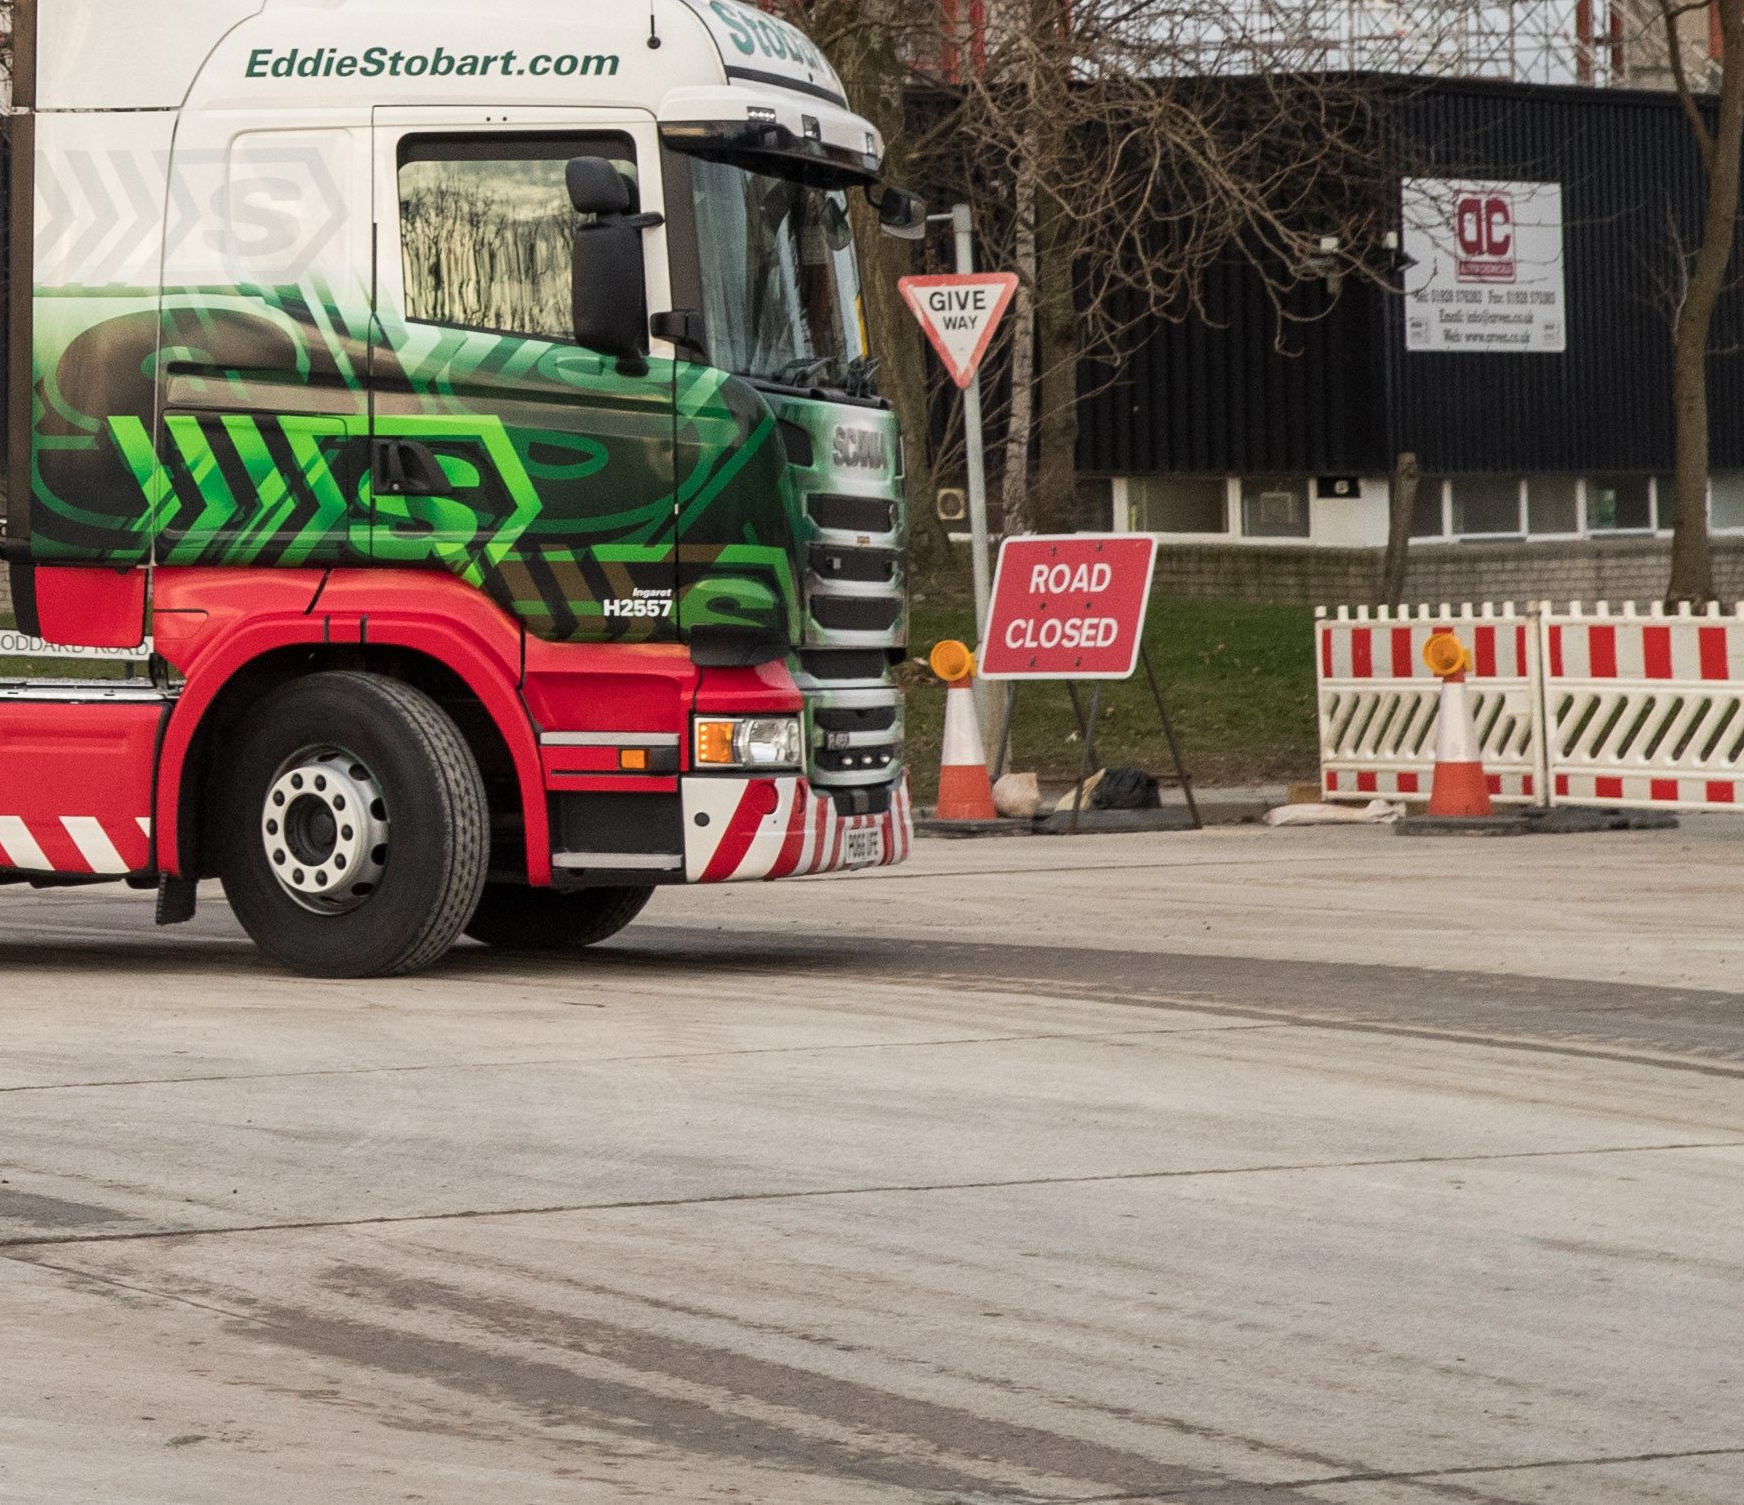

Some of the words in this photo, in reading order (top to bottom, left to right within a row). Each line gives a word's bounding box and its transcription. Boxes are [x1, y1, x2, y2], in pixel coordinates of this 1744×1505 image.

[244, 46, 620, 78] EddieStobart.com
[929, 289, 986, 312] GIVE
[943, 316, 978, 331] WAY
[1028, 562, 1113, 594] ROAD
[603, 599, 673, 617] H2557
[1004, 617, 1119, 650] CLOSED
